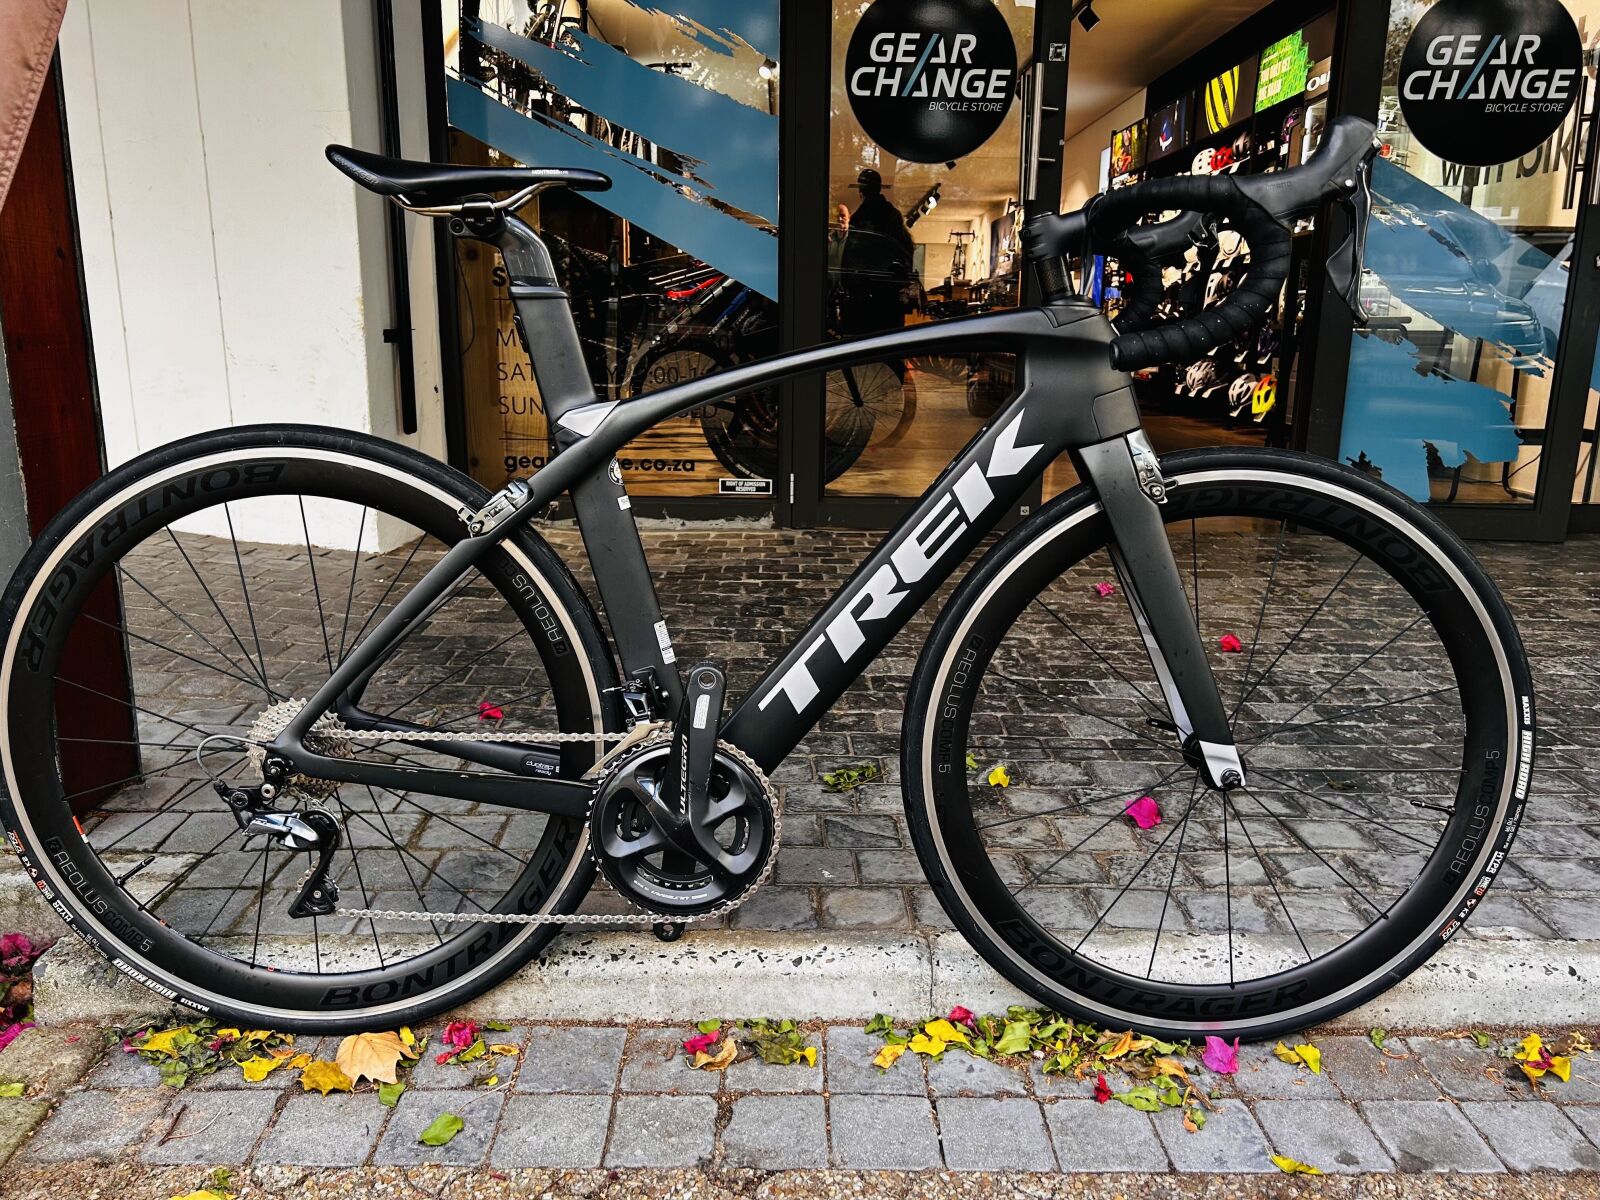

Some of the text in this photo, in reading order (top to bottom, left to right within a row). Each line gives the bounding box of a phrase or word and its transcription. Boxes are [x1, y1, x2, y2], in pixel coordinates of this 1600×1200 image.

[869, 32, 977, 64] GEAR
[1425, 34, 1541, 66] GEAR
[851, 66, 1011, 98] CHANGE
[928, 101, 1003, 112] BICYCLE STORE
[1403, 69, 1576, 100] CHANGE
[1484, 102, 1565, 113] BICYCLE STORE
[19, 462, 286, 673] BONTRAGER
[758, 407, 1045, 715] TREK
[1165, 485, 1455, 594] BONTRAGE
[512, 573, 563, 642] AEOLUS
[943, 648, 977, 719] AEOLUS
[679, 733, 688, 815] ULTEGRA
[938, 763, 951, 773] 5
[1515, 695, 1533, 800] MAXXIS HIGH ROAD
[1450, 805, 1490, 875] AEOLUS
[1485, 750, 1500, 760] 5
[1487, 851, 1505, 875] HYPR
[53, 900, 74, 923] HYPR
[54, 851, 107, 915] AEOLUS
[139, 938, 153, 952] 5
[112, 957, 210, 1012] MAXXIS HIGH ROAD
[995, 918, 1310, 1018] BONTRAGER
